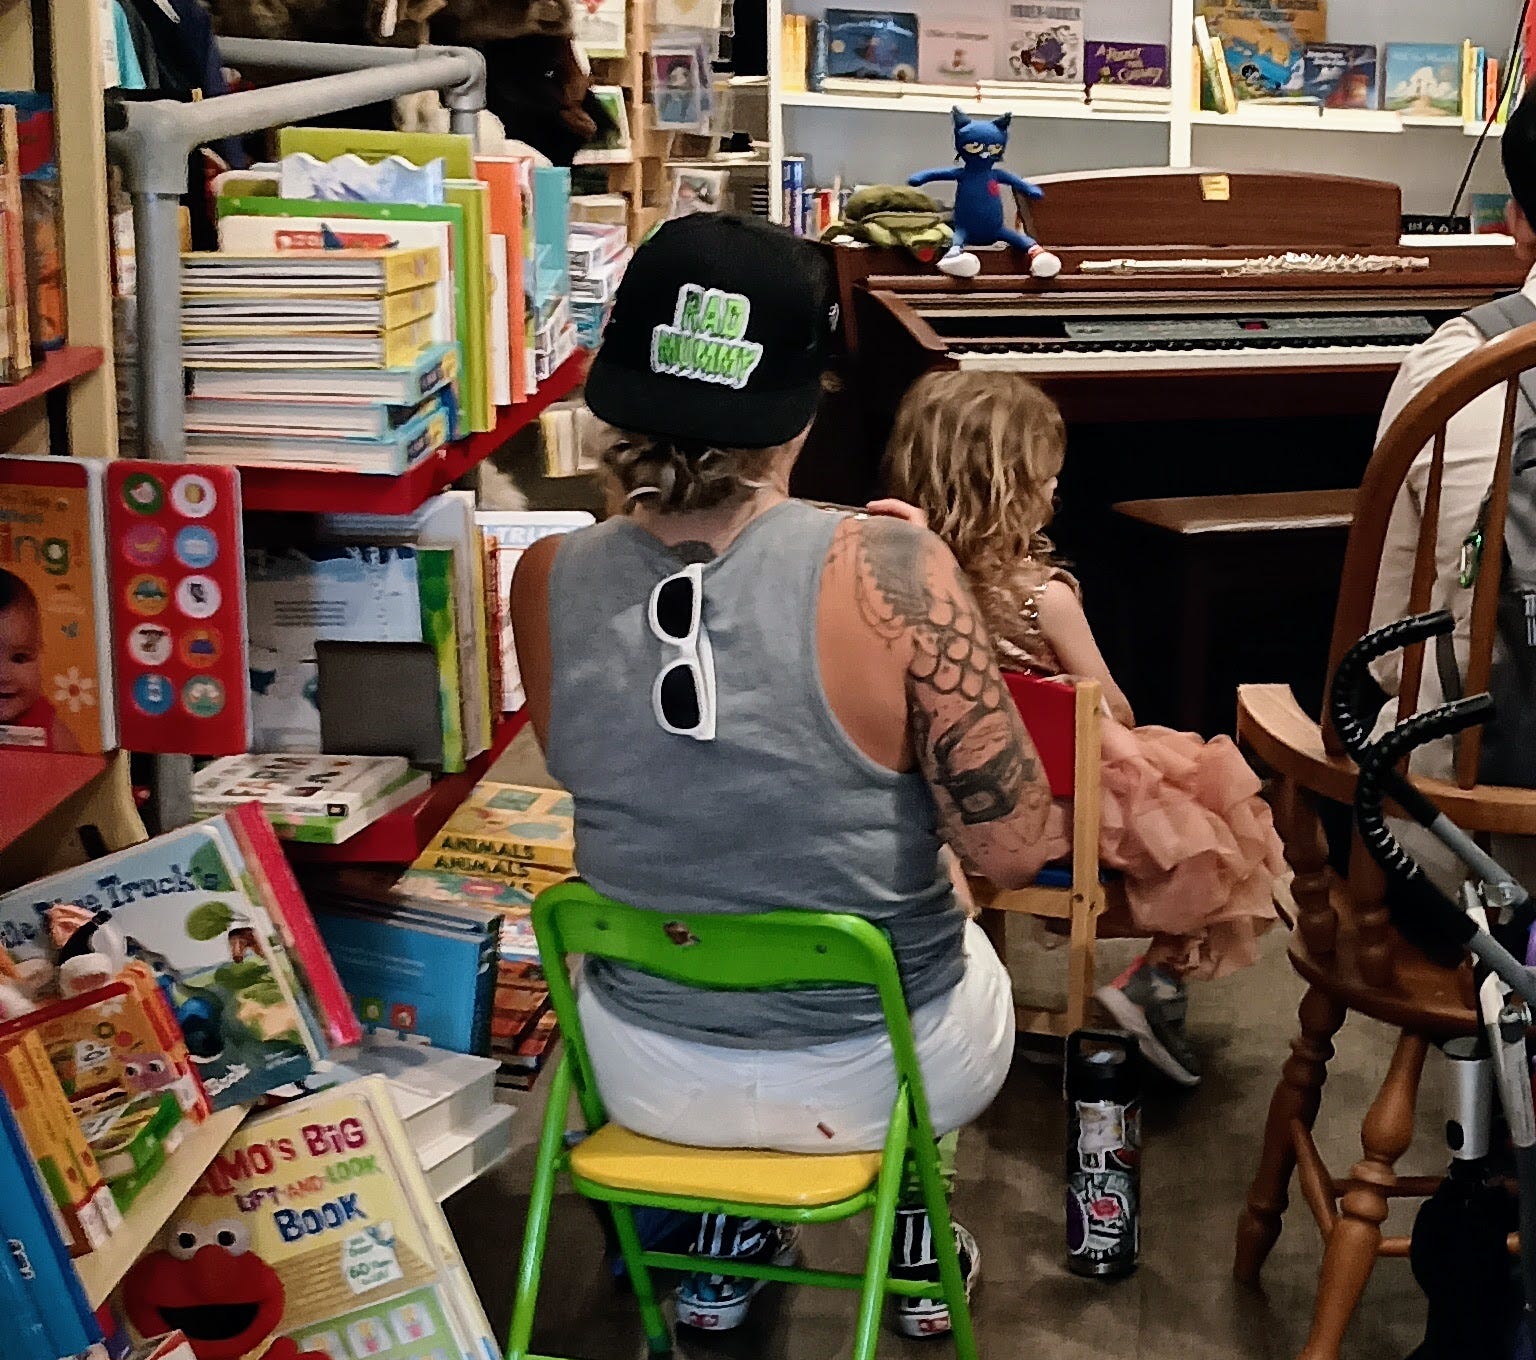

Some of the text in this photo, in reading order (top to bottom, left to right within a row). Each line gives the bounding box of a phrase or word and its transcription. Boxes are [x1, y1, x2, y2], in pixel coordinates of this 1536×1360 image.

[682, 290, 747, 339] RAD
[434, 855, 530, 878] ANIMALS
[442, 835, 536, 861] ANIMALS
[273, 1192, 368, 1242] BOOK
